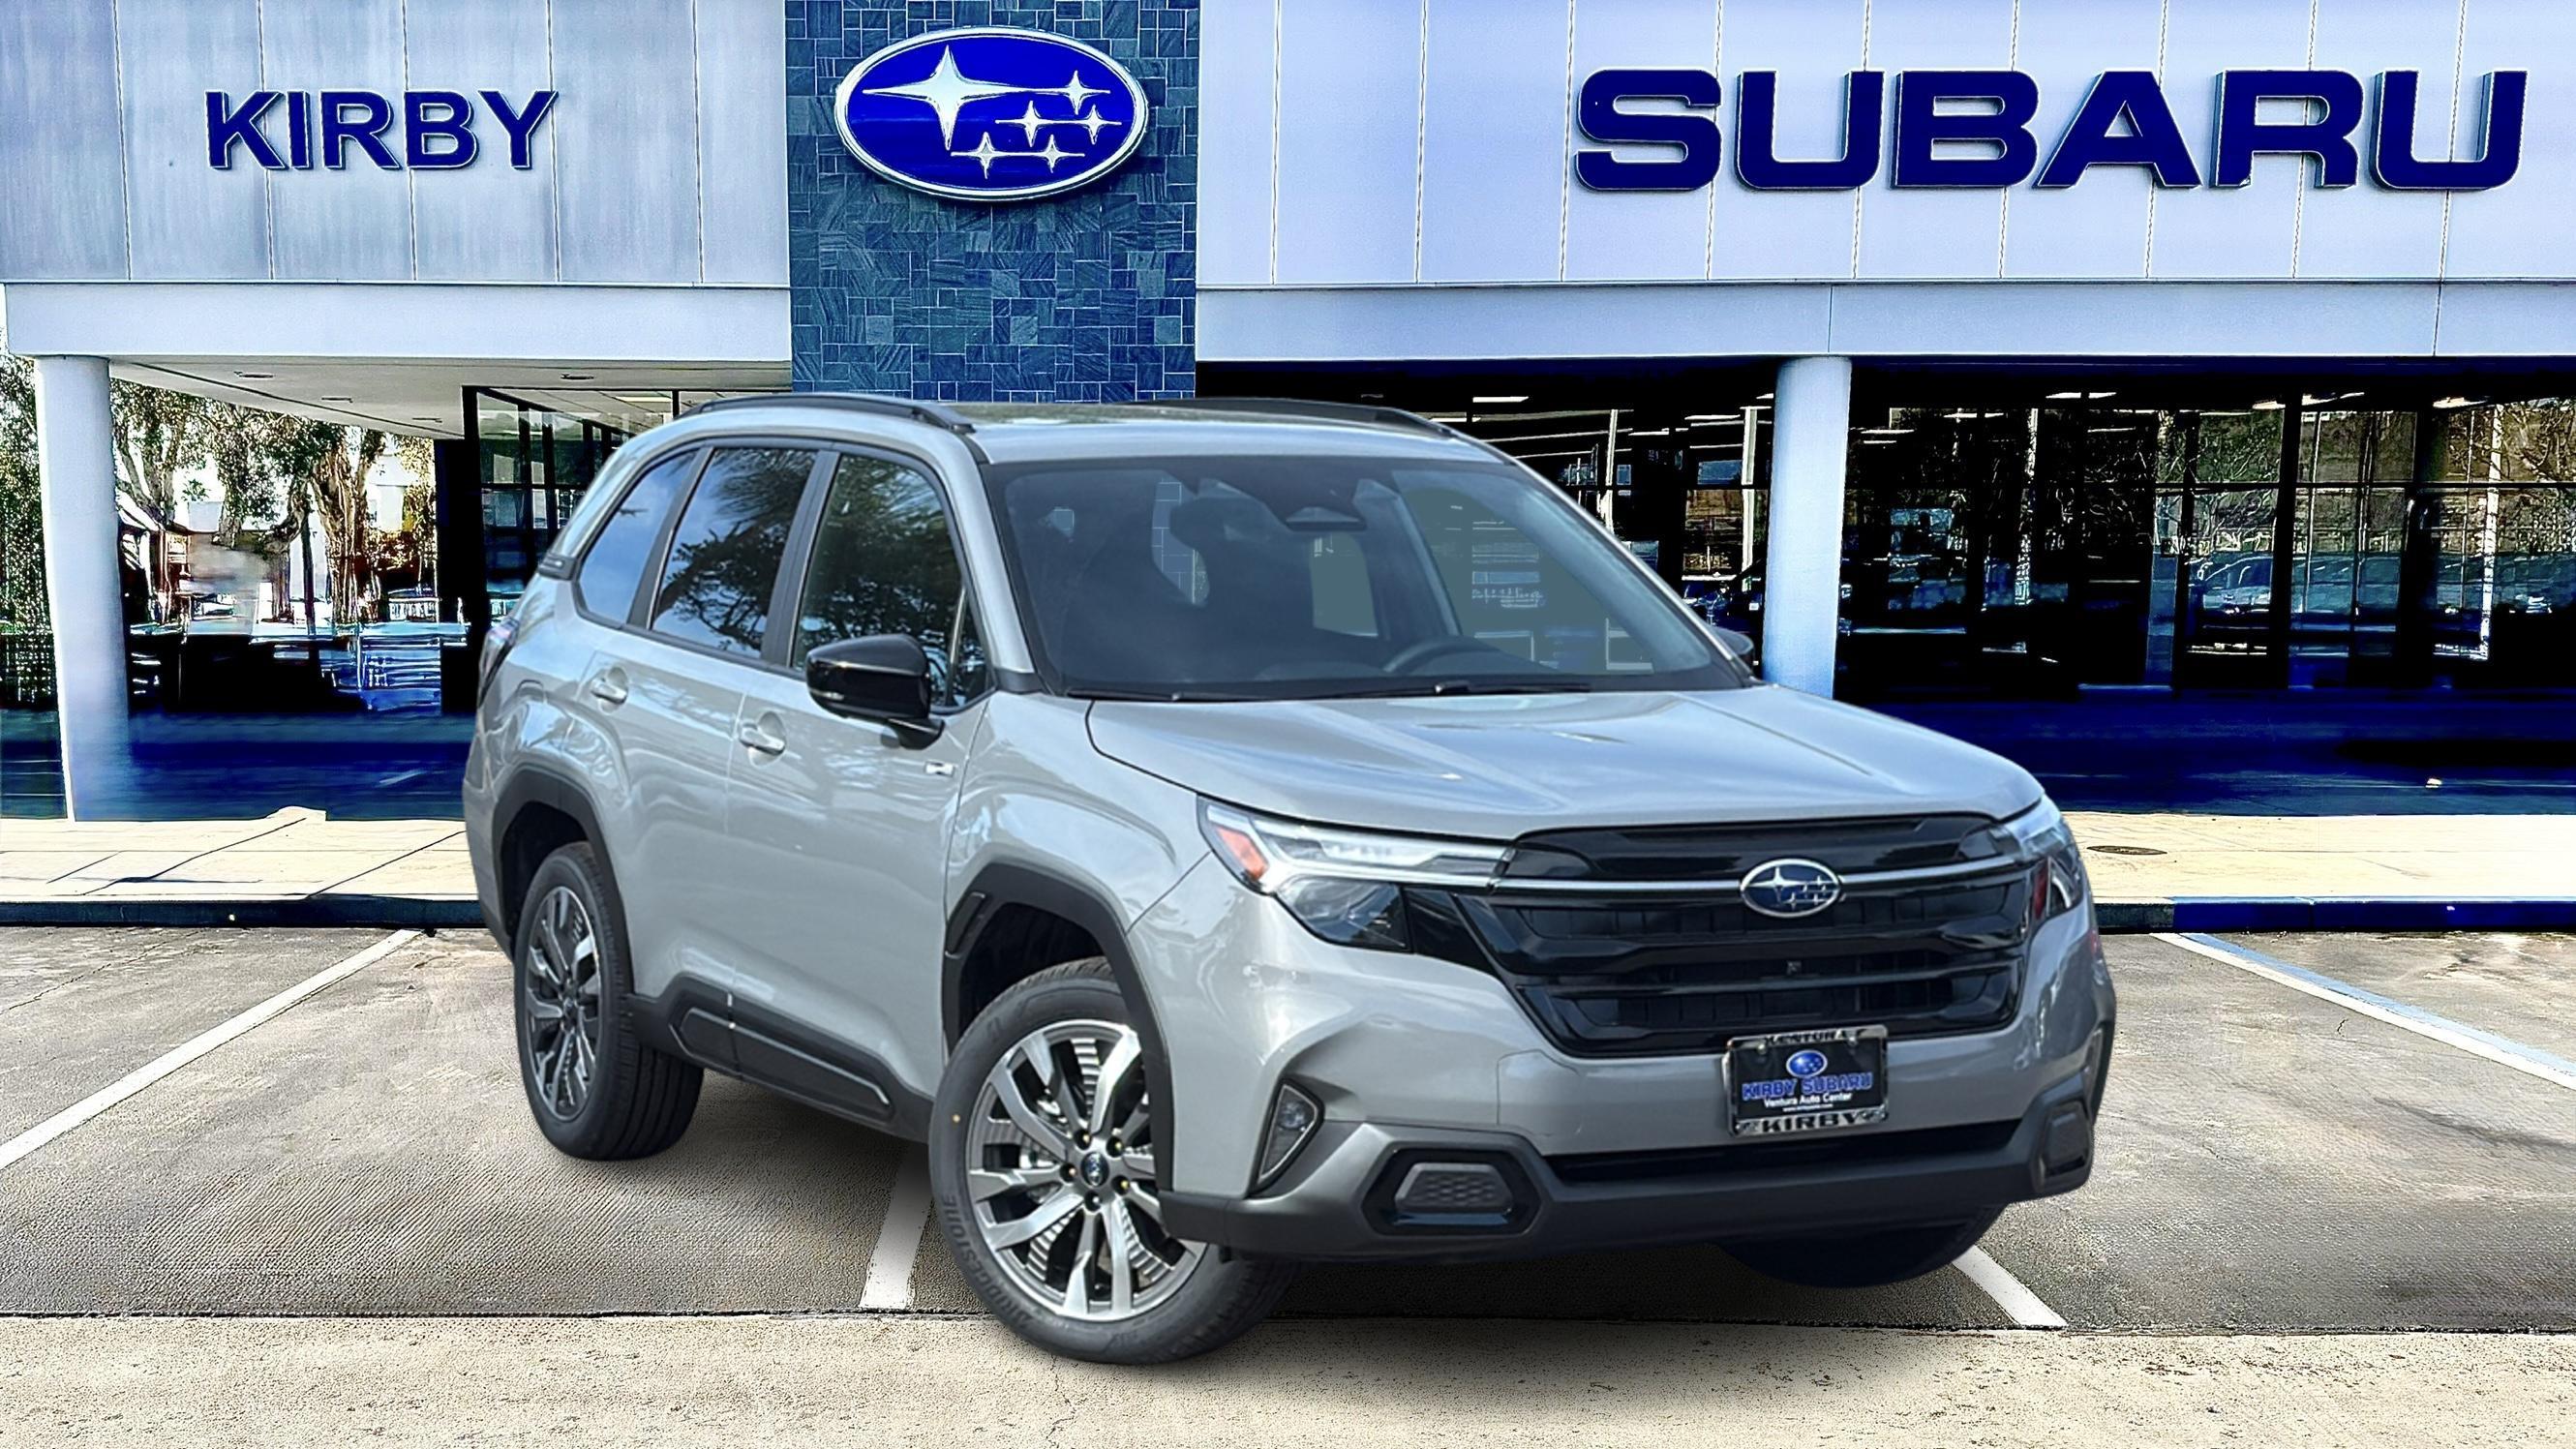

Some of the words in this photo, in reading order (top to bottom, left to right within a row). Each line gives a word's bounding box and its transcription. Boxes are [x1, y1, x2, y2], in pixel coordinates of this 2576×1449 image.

[204, 89, 559, 170] KIRBY
[1574, 68, 2528, 191] SUBARU
[1743, 1077, 1798, 1101] KIRBY
[1802, 1072, 1874, 1095] SUBARU
[1764, 1096, 1798, 1108] Ventura
[1800, 1093, 1821, 1104] Auto
[1823, 1091, 1853, 1102] Center
[1762, 1112, 1860, 1133] KIRBY
